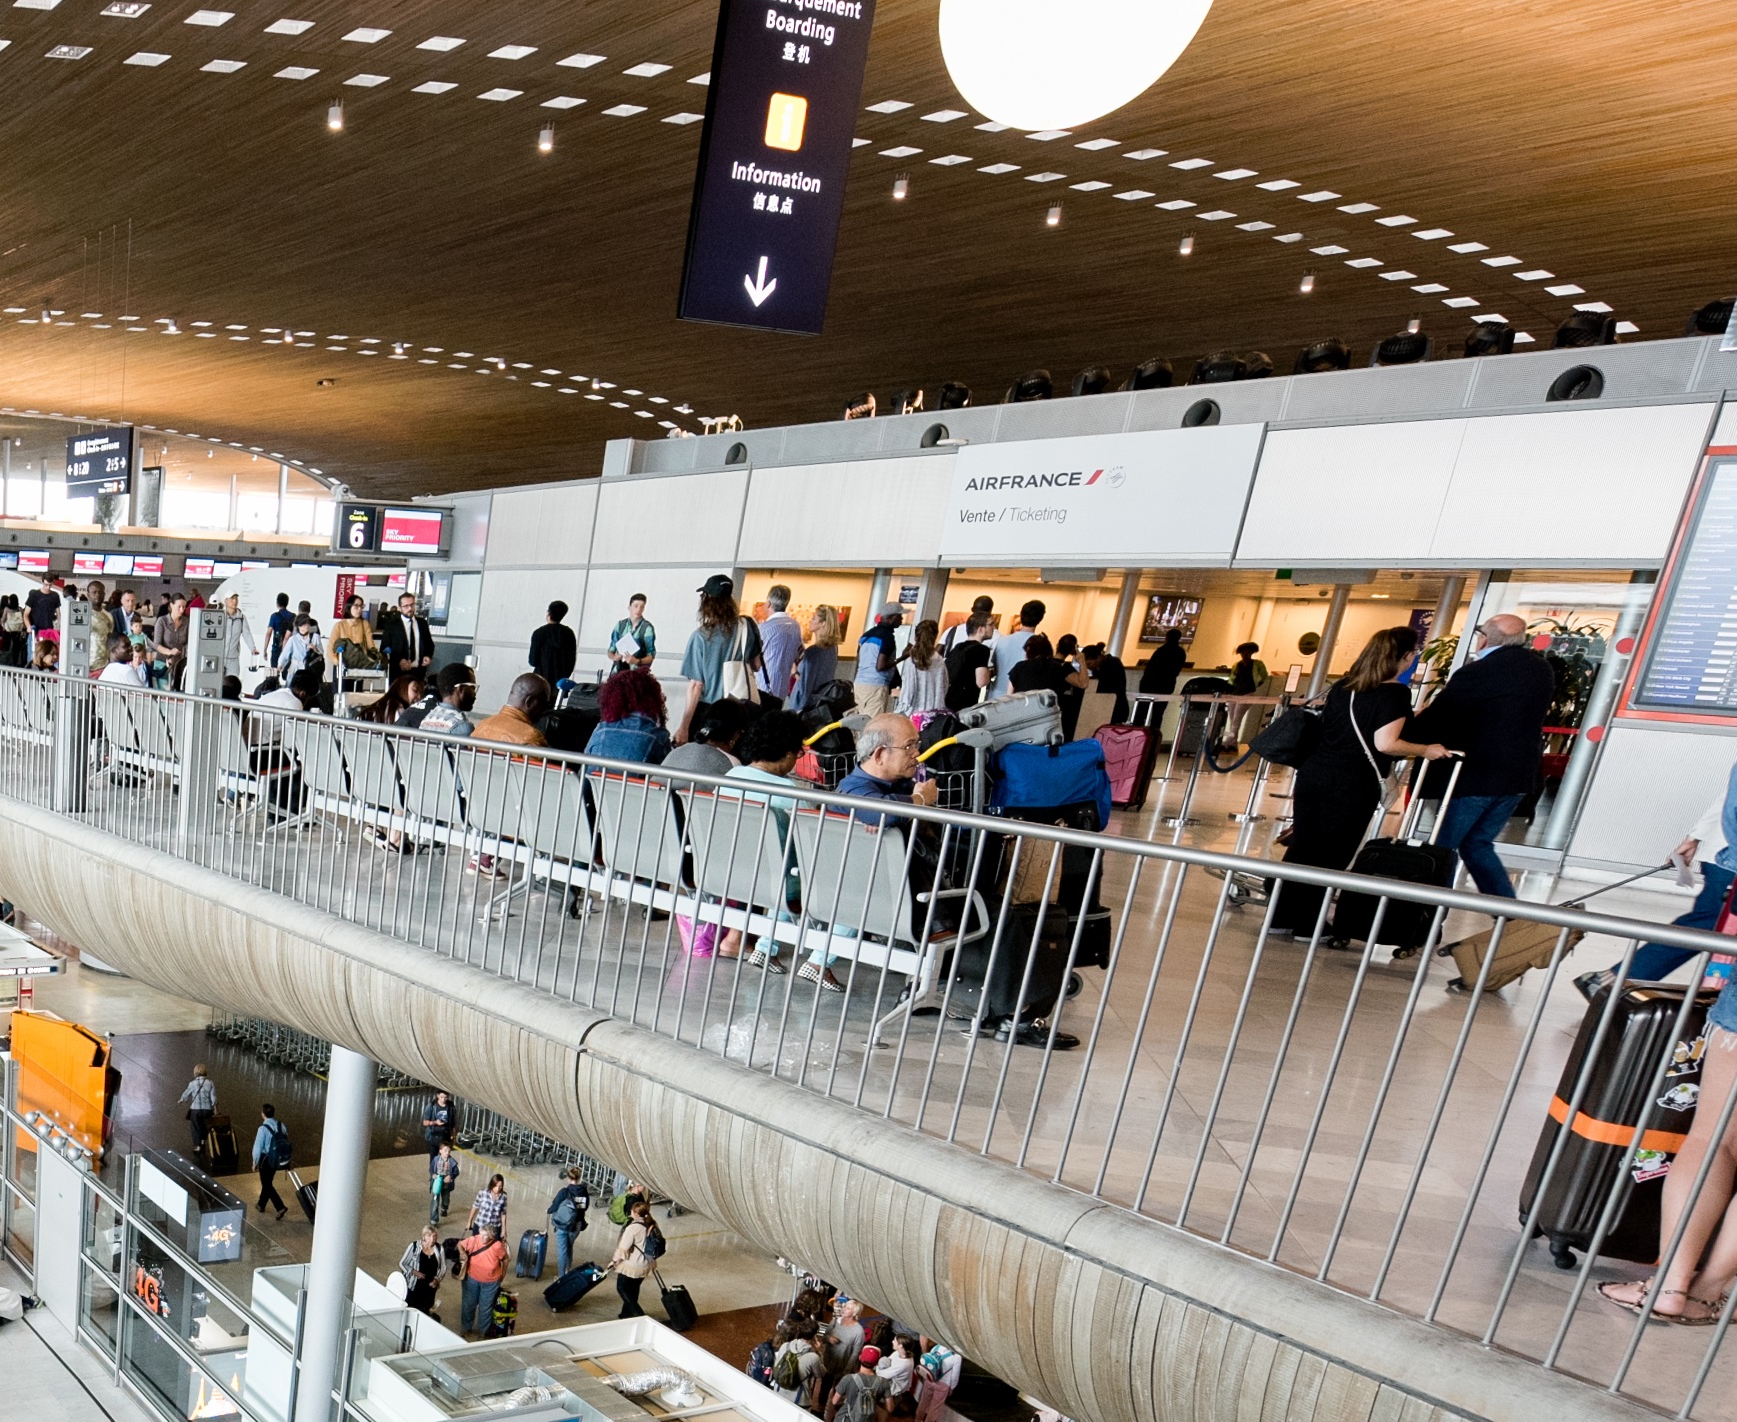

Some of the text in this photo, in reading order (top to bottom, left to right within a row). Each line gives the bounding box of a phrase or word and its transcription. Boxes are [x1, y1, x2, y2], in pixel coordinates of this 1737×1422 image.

[766, 9, 835, 46] Boarding
[782, 41, 810, 64] 登机
[731, 161, 821, 193] Information
[753, 191, 794, 215] 信息点
[959, 509, 996, 523] Vente
[1009, 506, 1067, 524] Ticketing
[350, 522, 365, 548] 6
[385, 534, 415, 542] PRIORITY
[212, 1229, 230, 1242] 4G
[136, 1267, 159, 1314] 4G
